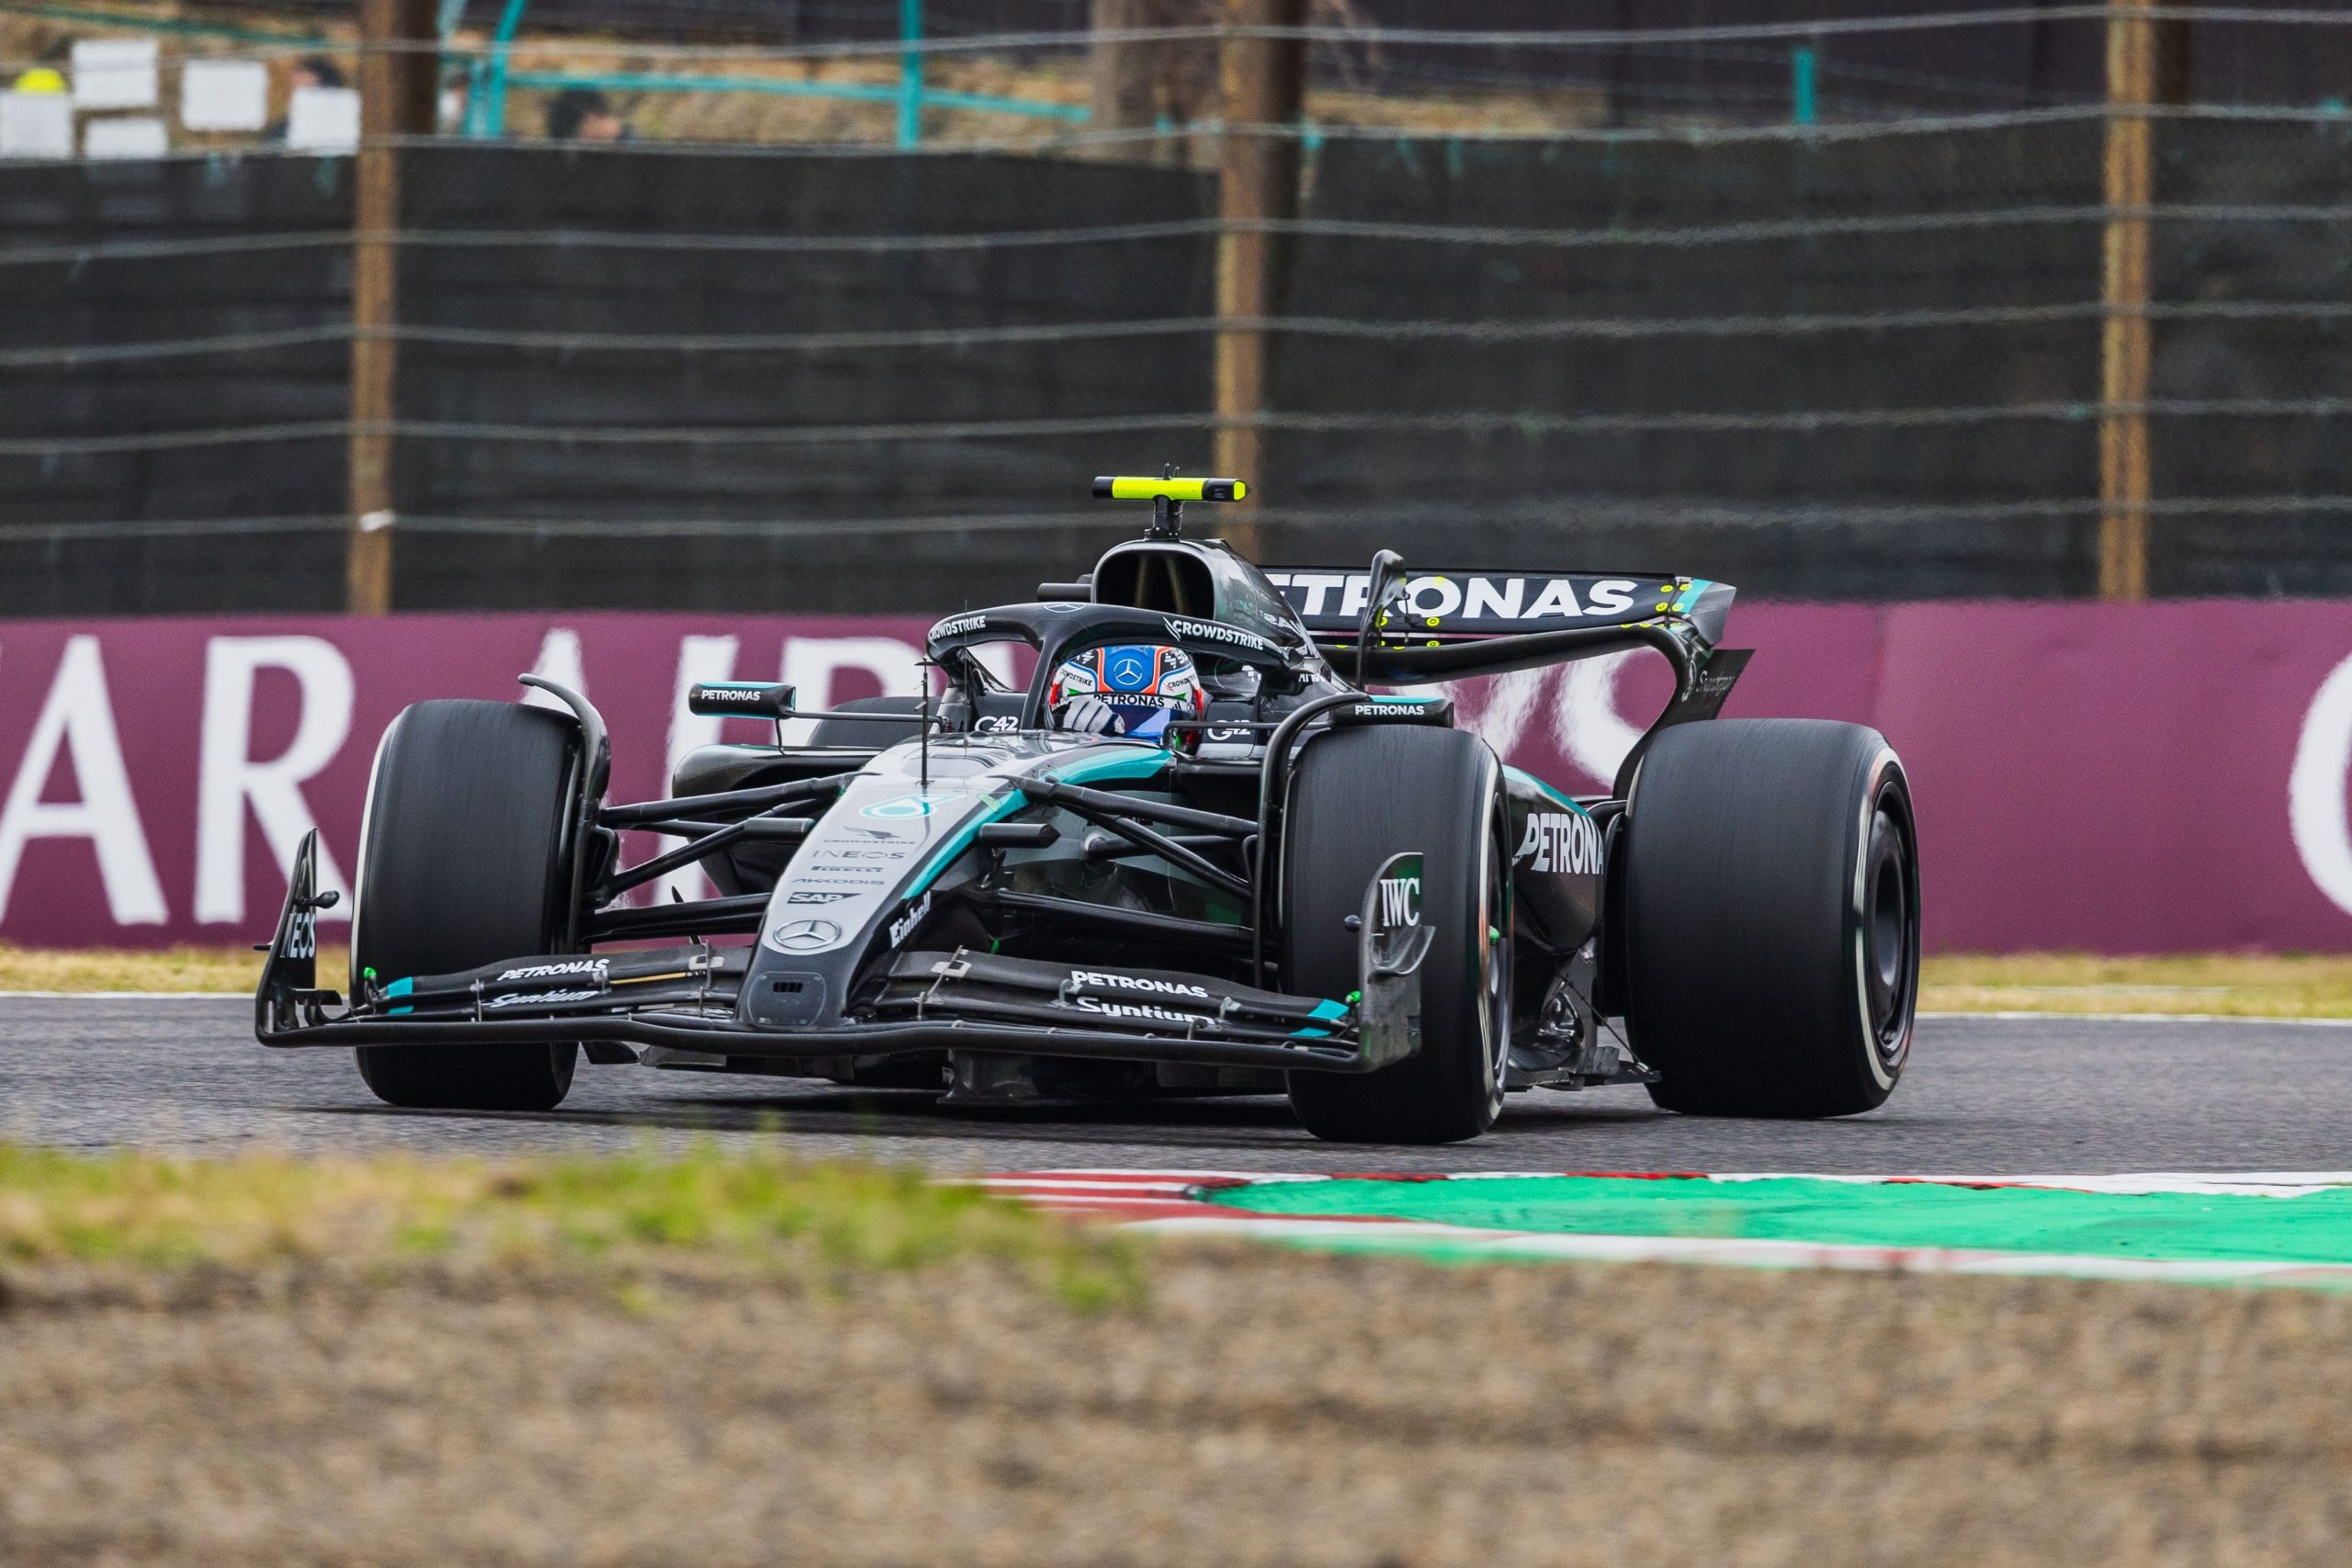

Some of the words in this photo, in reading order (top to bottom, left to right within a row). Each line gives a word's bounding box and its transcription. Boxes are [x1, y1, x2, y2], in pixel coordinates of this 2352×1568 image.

[1264, 574, 1639, 619] TRONAS
[929, 615, 986, 641] CROWDSTRIKE
[1171, 619, 1263, 651] CROWDSTRIKE
[701, 690, 761, 701] PETRONAS
[975, 716, 1019, 732] G42
[1355, 705, 1425, 716] PETRONAS
[812, 851, 907, 860] INEOS
[1512, 813, 1604, 874] PETRONA
[789, 892, 844, 904] SAP
[1379, 877, 1420, 927] IWC
[889, 891, 932, 949] Einhell
[497, 958, 610, 982] PETRONAS
[1070, 970, 1209, 998] PETRONAS
[1077, 997, 1216, 1025] Syntium
